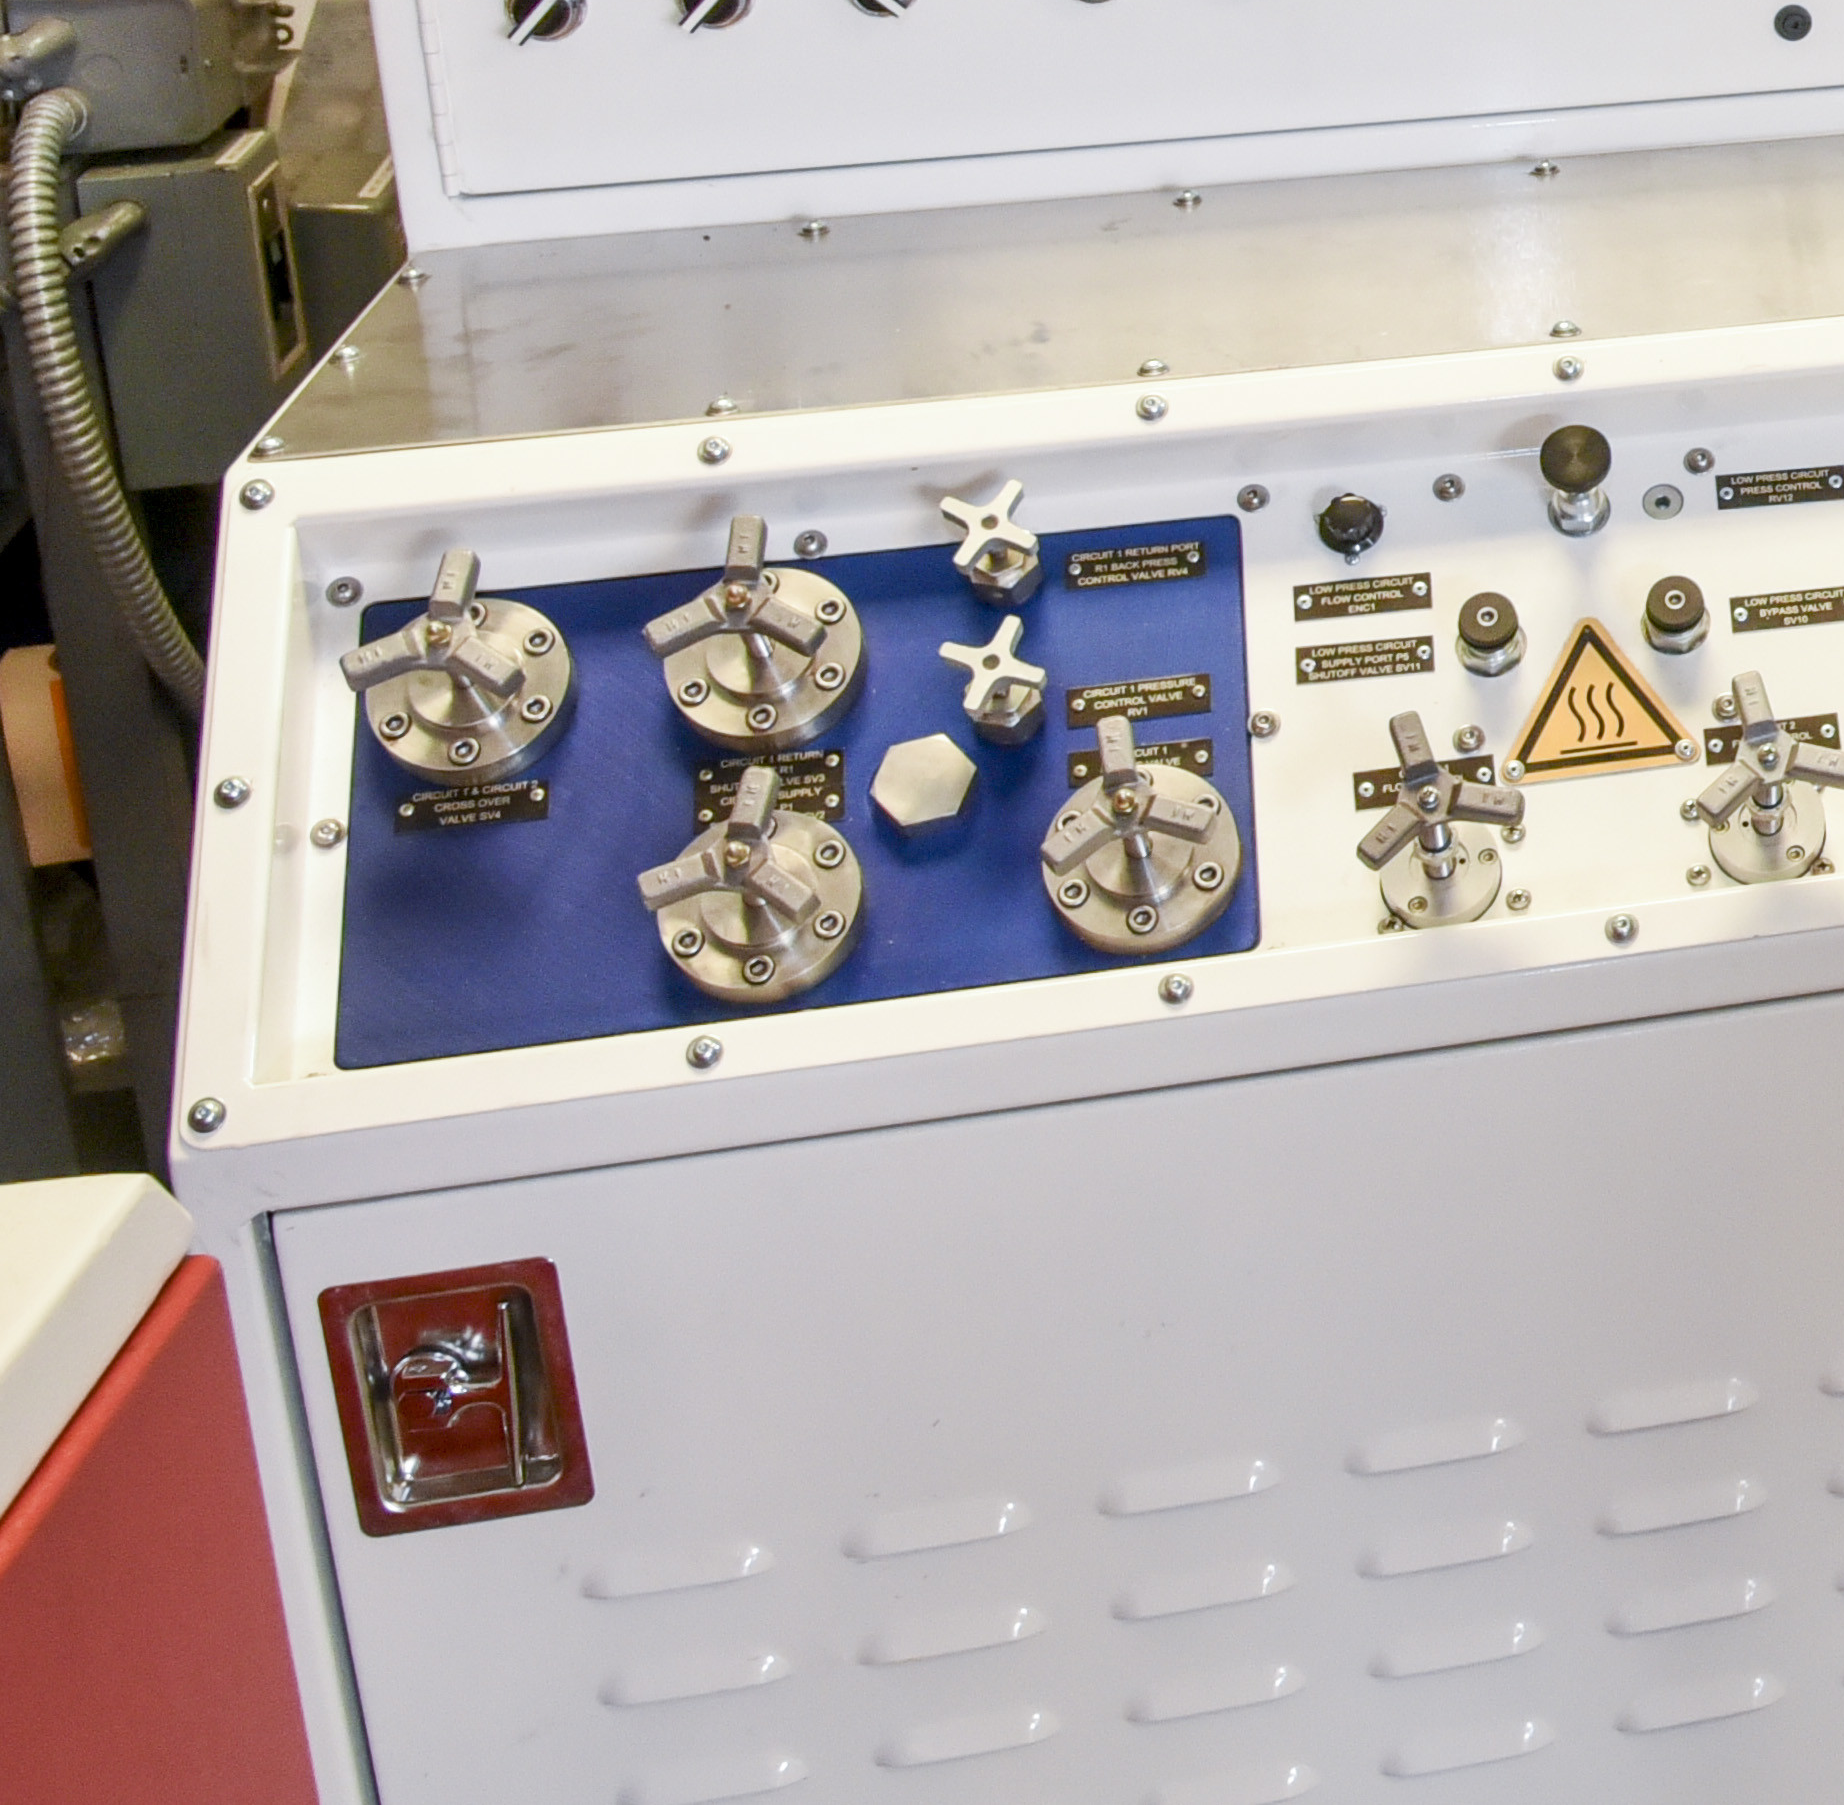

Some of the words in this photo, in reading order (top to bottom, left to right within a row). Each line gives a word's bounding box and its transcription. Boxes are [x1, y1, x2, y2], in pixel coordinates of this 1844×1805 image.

[1731, 477, 1753, 485] LOW
[1756, 473, 1788, 482] PRESS
[1791, 469, 1829, 479] CIRCUIT
[1741, 486, 1773, 495] PRESS
[1775, 482, 1822, 492] CONTROL
[1769, 494, 1793, 502] RV12
[1072, 551, 1114, 562] CIRCUIT
[1125, 545, 1168, 557] RETURN
[1171, 543, 1199, 553] PORT
[1095, 564, 1108, 573] R1
[1111, 560, 1139, 571] BACK
[1142, 557, 1177, 568] PRESS
[1078, 574, 1129, 586] CONTROL
[1132, 570, 1165, 581] VALVE
[1167, 567, 1188, 577] RV4
[1309, 585, 1333, 595] LOW
[1335, 581, 1370, 592] PRESS
[1373, 577, 1413, 588] CIRCUIT
[1321, 595, 1351, 605] FLOW
[1353, 590, 1404, 602] CONTROL
[1745, 597, 1768, 607] LOW
[1770, 593, 1803, 603] PRESS
[1805, 589, 1844, 600] CIRCUIT
[1348, 604, 1375, 613] ENC1
[1760, 607, 1799, 617] BYPASS
[1801, 602, 1832, 612] VALVE
[1784, 616, 1808, 625] SV10
[1312, 648, 1335, 657] LOW
[1338, 644, 1373, 654] PRESS
[1376, 640, 1417, 651] CIRCUIT
[1321, 658, 1363, 668] SUPPLY
[1365, 654, 1394, 665] PORT
[1309, 669, 1357, 681] SHUTOFF
[1359, 665, 1393, 675] VALVE
[1396, 663, 1420, 672] SV11
[1083, 687, 1126, 699] CIRCUIT
[1138, 678, 1195, 692] PRESSURE
[1094, 697, 1146, 710] CONTROL
[1149, 691, 1183, 702] VALVE
[1127, 707, 1148, 716] RV1
[412, 788, 458, 802] CIRCUIT
[482, 781, 528, 794] CIRCUIT
[434, 800, 475, 813] CROSS
[478, 797, 510, 809] OVER
[439, 813, 477, 826] VALVE
[479, 811, 501, 821] SV4
